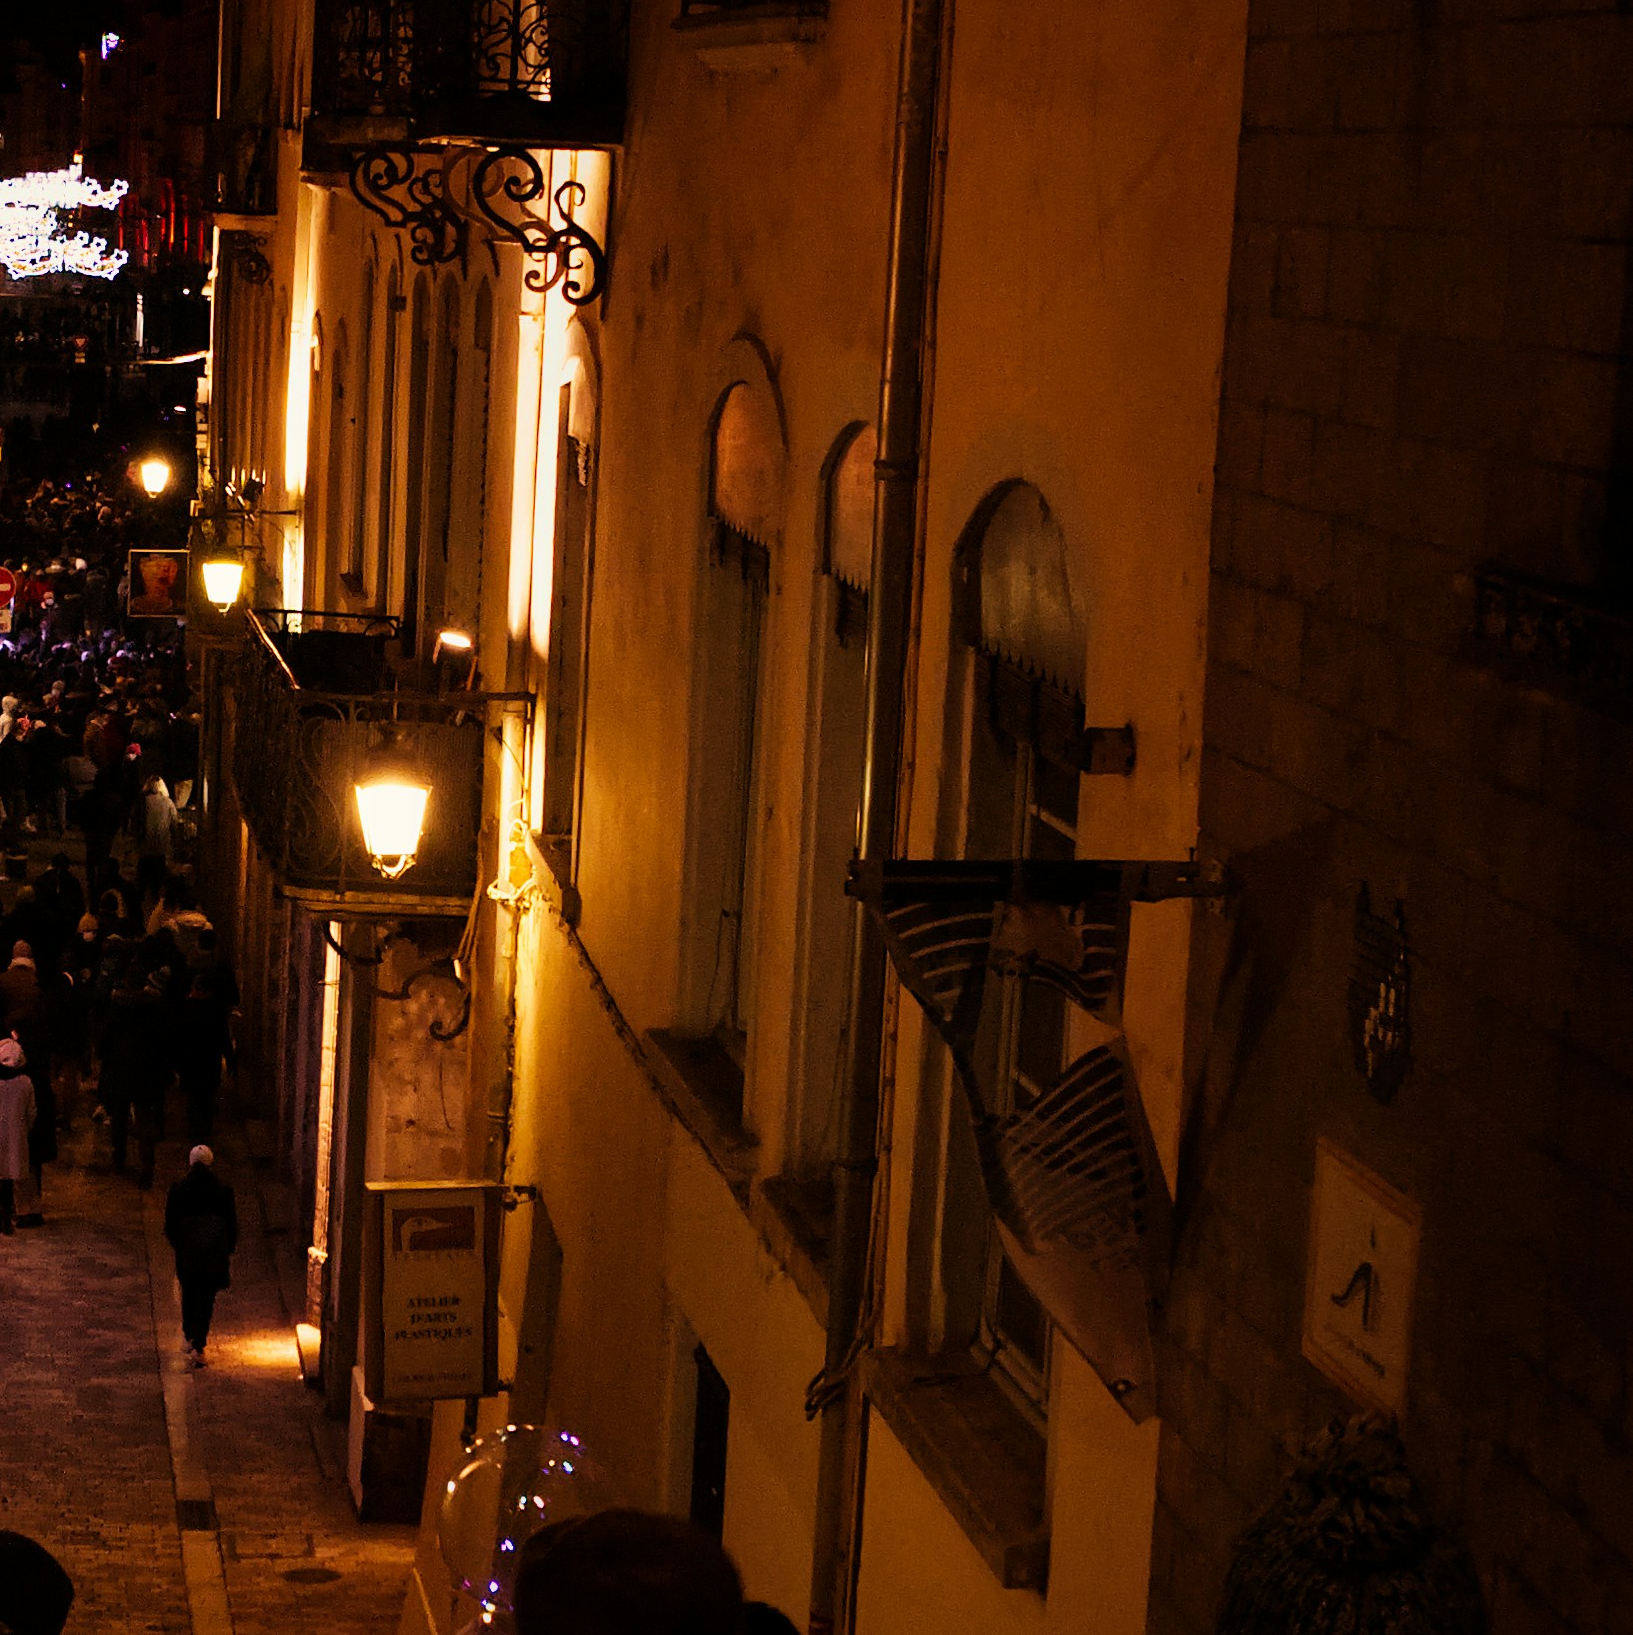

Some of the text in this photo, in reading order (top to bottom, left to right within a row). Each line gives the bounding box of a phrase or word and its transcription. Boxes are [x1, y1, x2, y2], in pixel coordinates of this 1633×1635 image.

[408, 1297, 460, 1308] ATELIER
[411, 1313, 457, 1324] D'ARTS
[395, 1327, 472, 1340] PLASTIQUES
